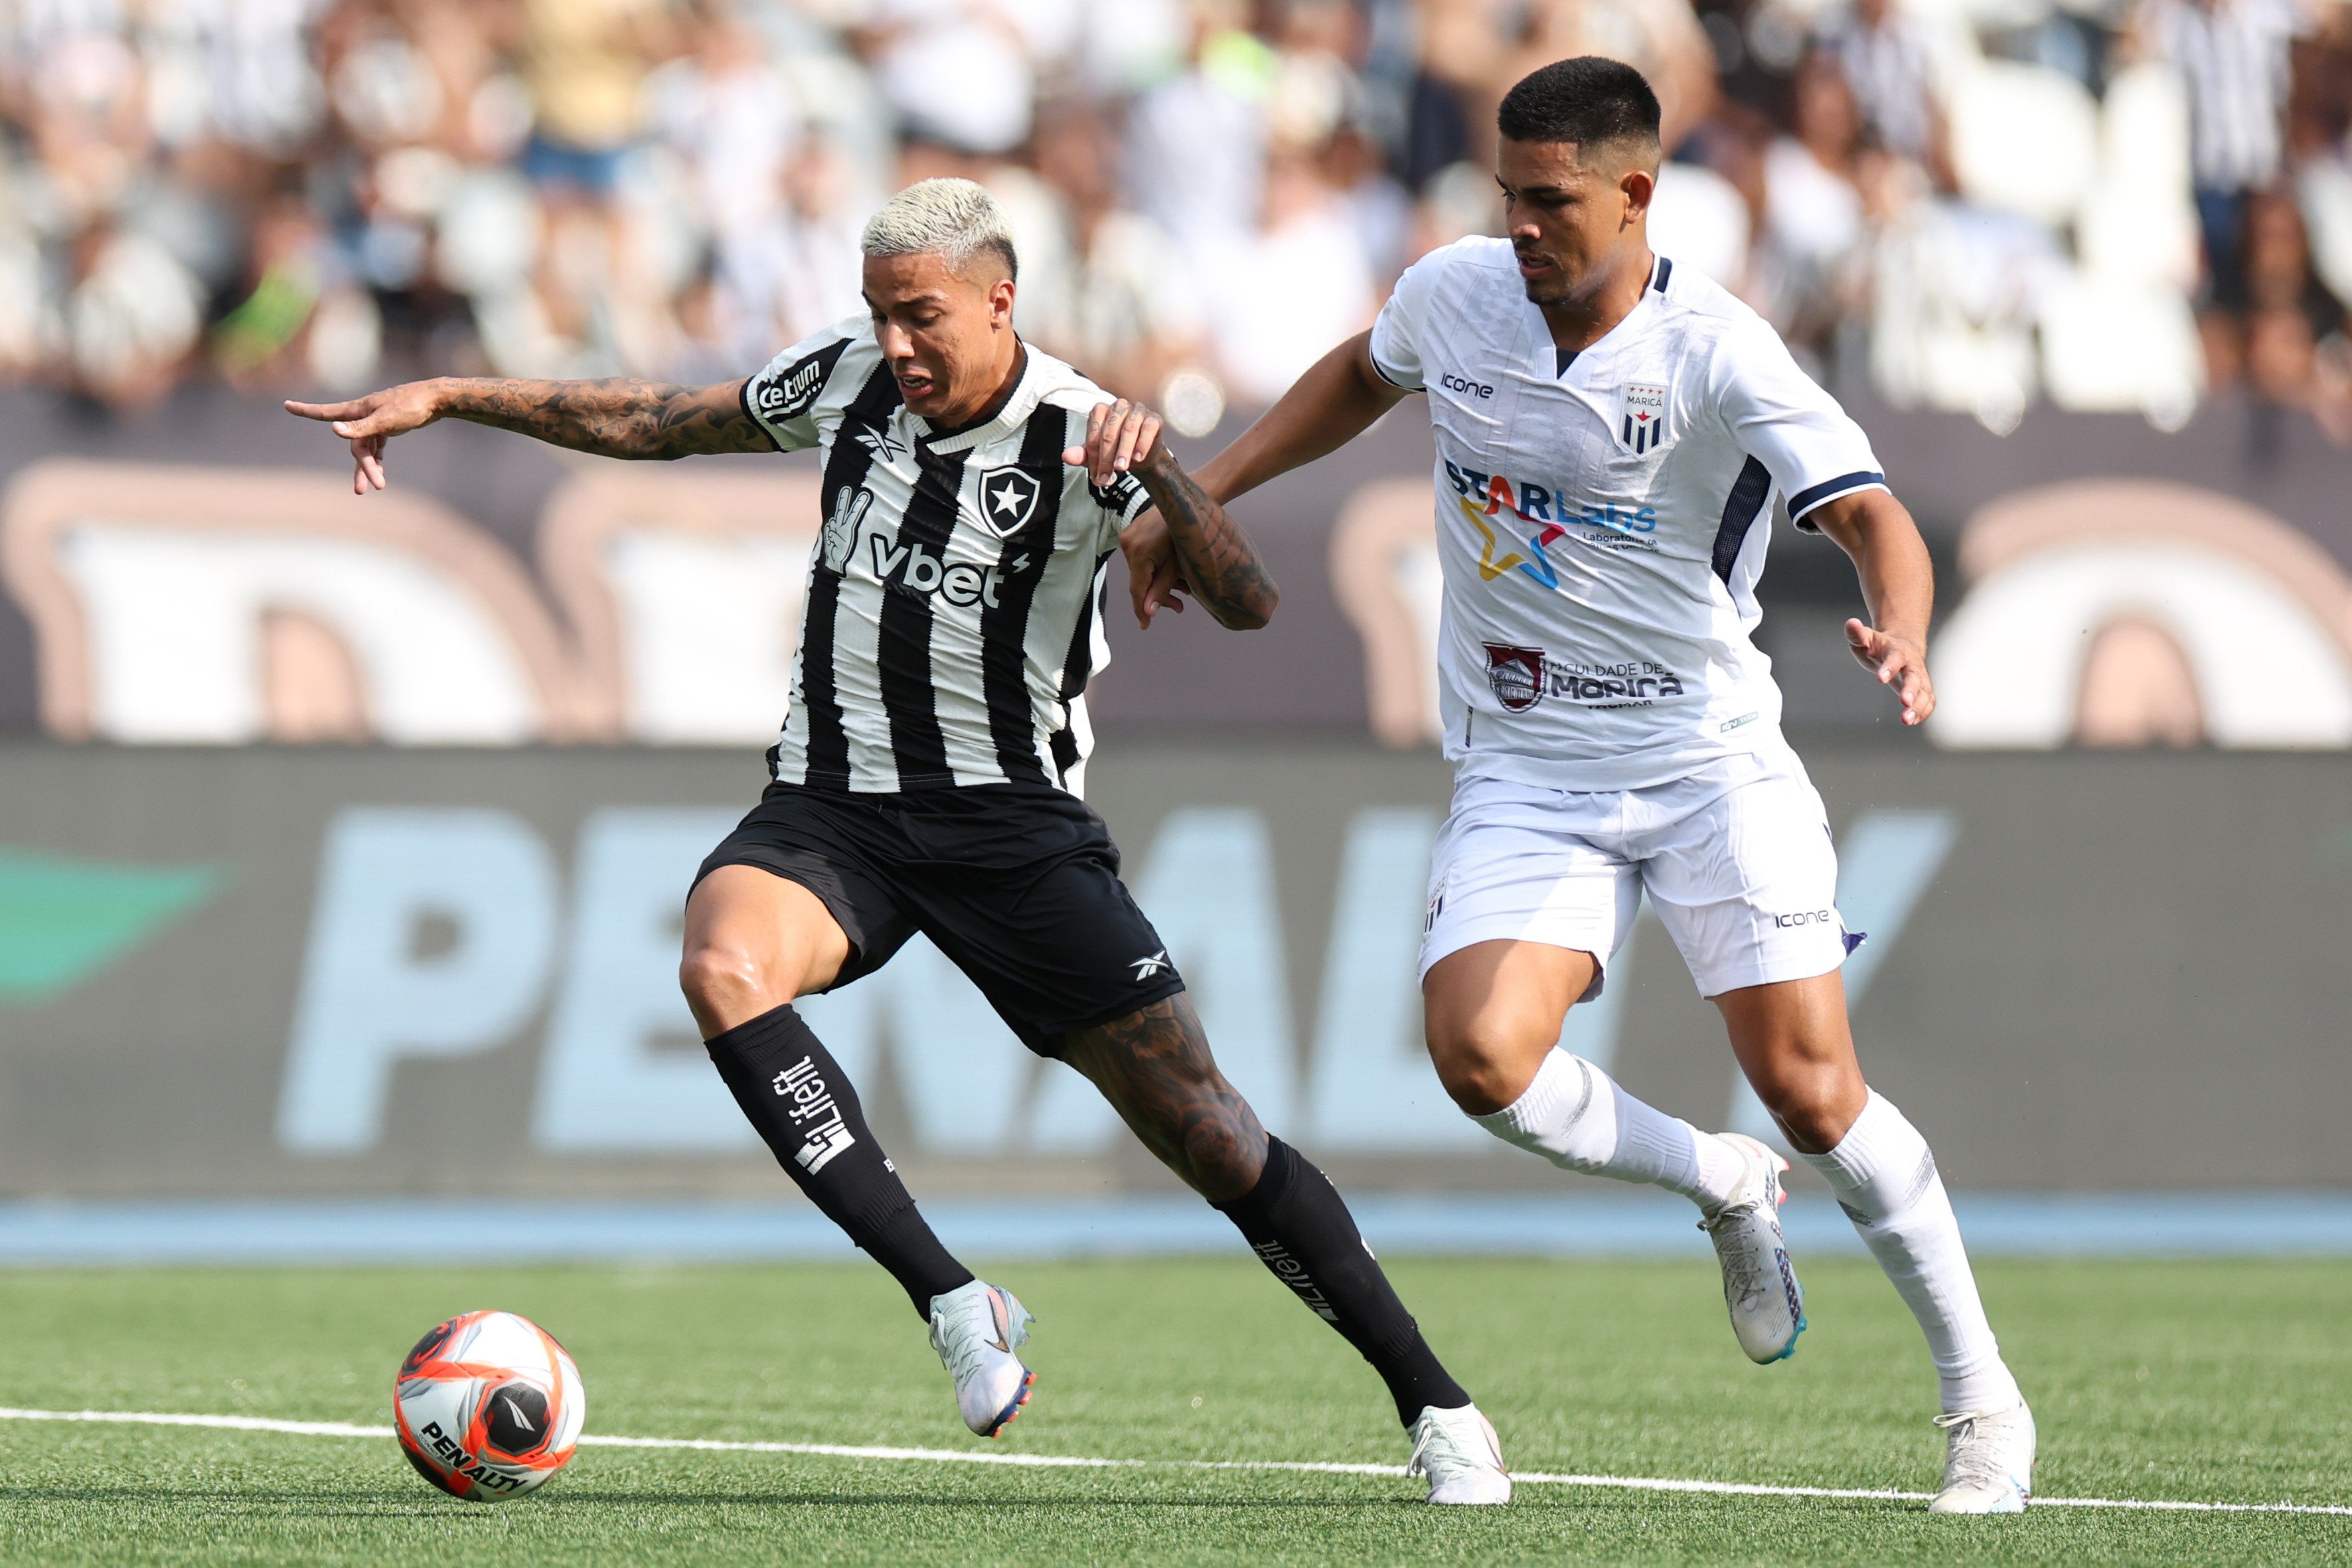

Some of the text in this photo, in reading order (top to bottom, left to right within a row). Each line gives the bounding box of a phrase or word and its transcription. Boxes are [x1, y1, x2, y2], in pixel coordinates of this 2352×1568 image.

[759, 360, 820, 408] Cetrum
[1626, 396, 1662, 407] MARICÁ
[873, 536, 1006, 609] vbet
[1642, 662, 1664, 674] DE
[274, 805, 1962, 1156] PEALY
[421, 1421, 529, 1492] PENALTY
